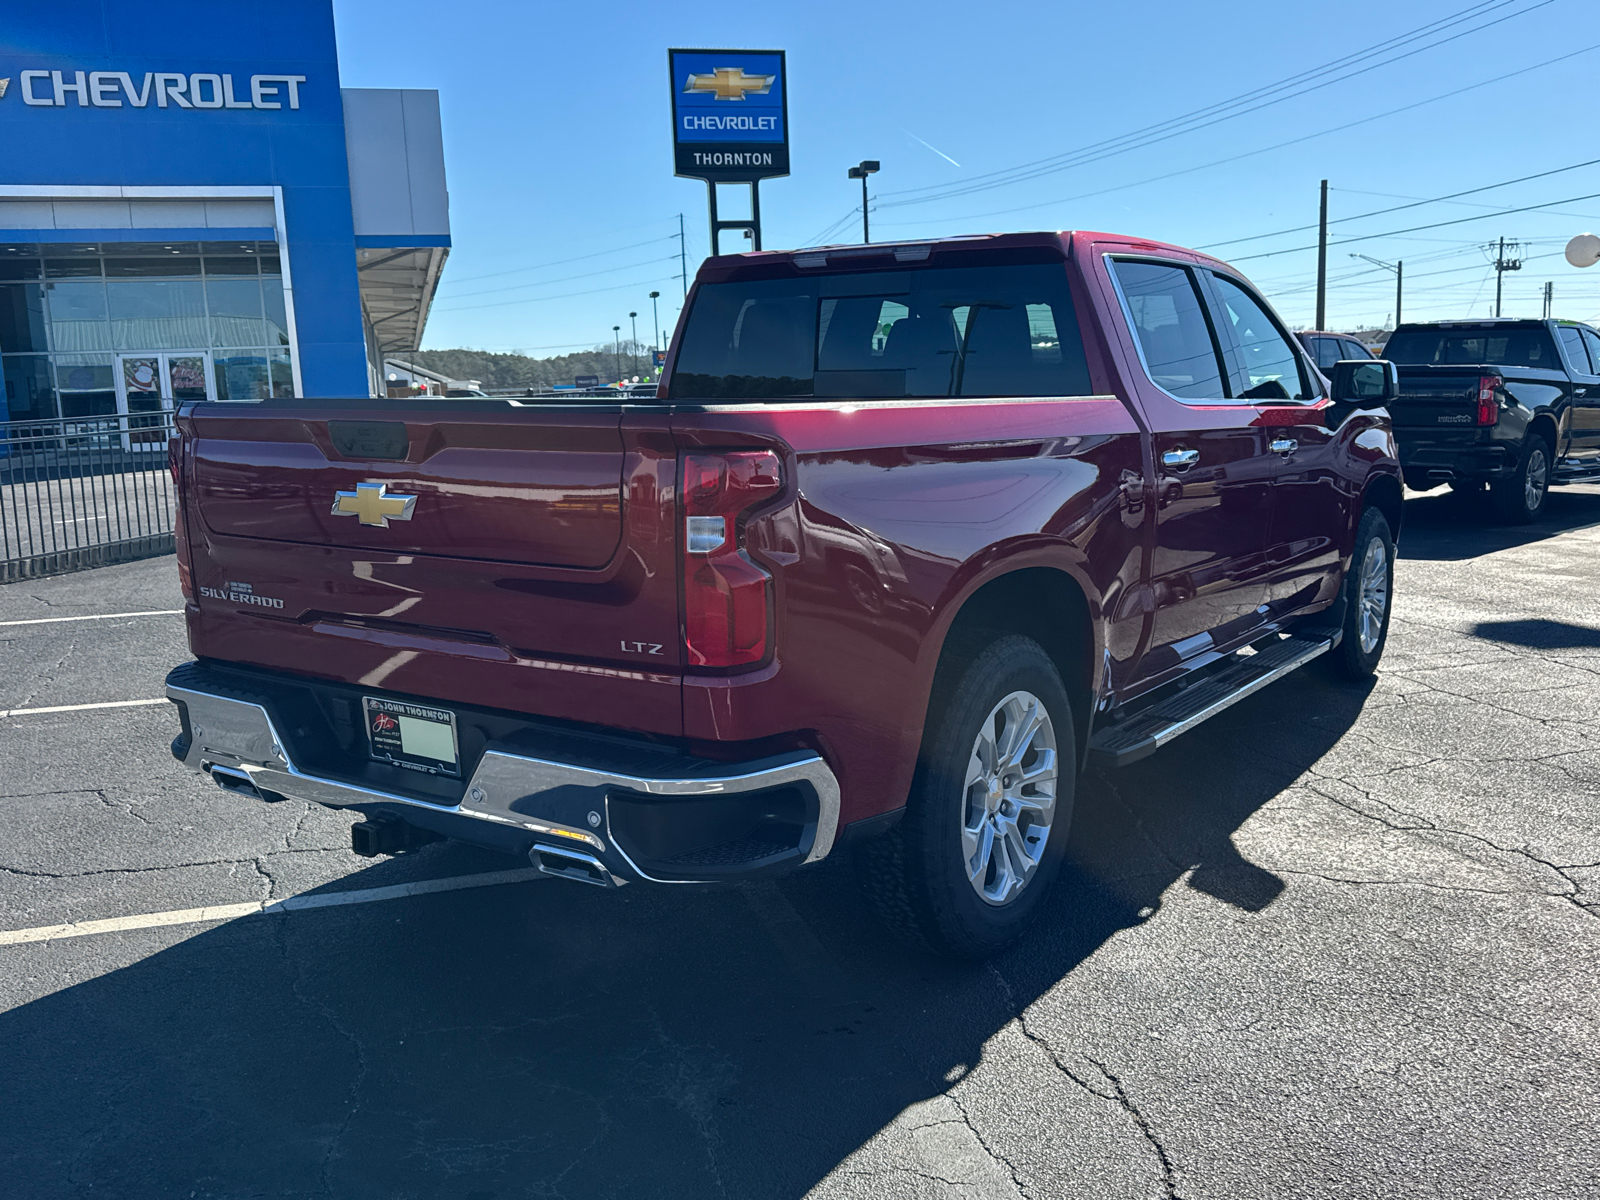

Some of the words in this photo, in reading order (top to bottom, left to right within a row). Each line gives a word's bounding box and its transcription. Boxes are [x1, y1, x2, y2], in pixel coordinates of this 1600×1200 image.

[20, 70, 306, 109] CHEVROLET
[683, 116, 777, 130] CHEVROLET
[693, 153, 772, 165] THORNTON
[200, 587, 284, 608] SILVERADO
[621, 640, 664, 655] LTZ
[384, 703, 405, 713] JOHN
[405, 707, 450, 722] THORNTON
[401, 763, 428, 773] CHEVROLET
